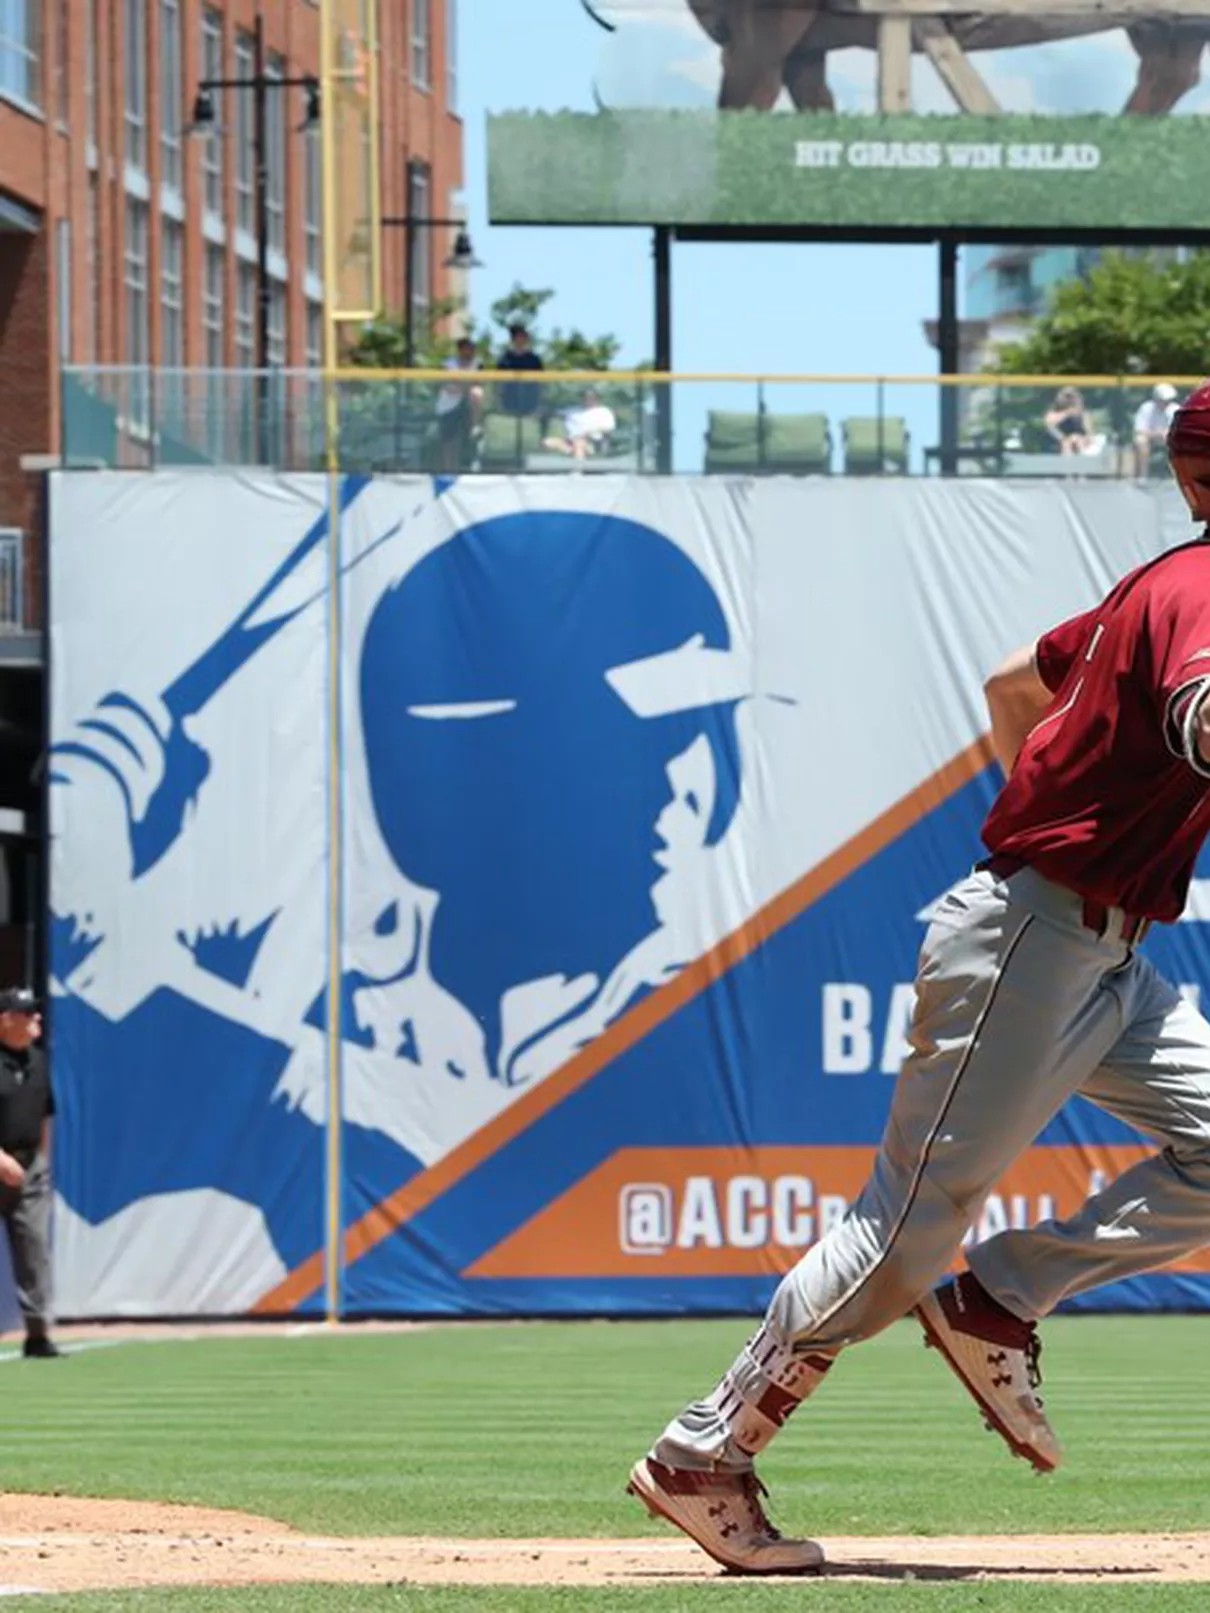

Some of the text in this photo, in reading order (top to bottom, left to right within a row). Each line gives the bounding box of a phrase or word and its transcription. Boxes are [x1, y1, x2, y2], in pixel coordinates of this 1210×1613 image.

[795, 140, 1100, 170] HIT GRASS WIN SALAD
